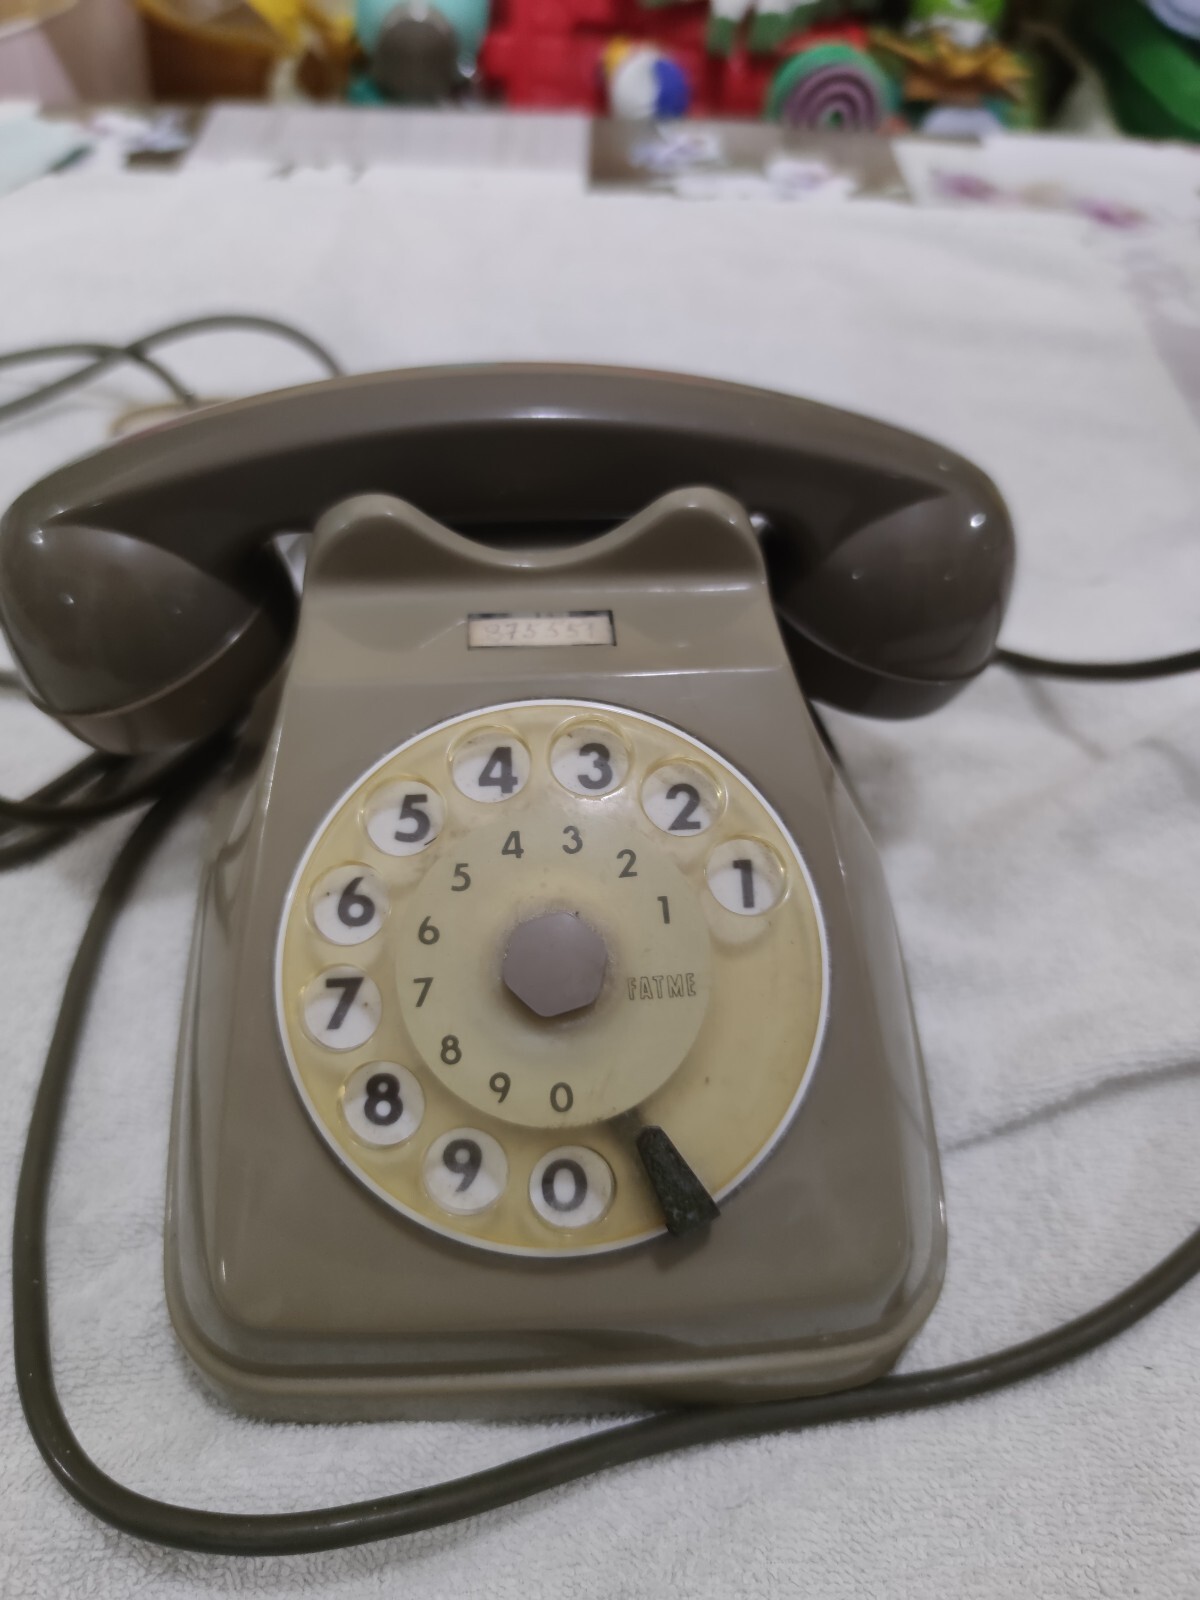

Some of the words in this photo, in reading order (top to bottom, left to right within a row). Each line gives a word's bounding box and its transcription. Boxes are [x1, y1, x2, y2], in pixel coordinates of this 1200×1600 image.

[478, 745, 519, 794] 4
[577, 741, 613, 790] 3
[394, 793, 432, 843] 5
[665, 782, 702, 831] 2
[501, 830, 525, 859] 4
[562, 825, 584, 855] 3
[450, 862, 472, 892] 5
[616, 848, 638, 879] 2
[731, 858, 755, 909] 1
[337, 876, 376, 928] 6
[657, 895, 671, 925] 1
[417, 915, 441, 946] 6
[324, 975, 365, 1030] 7
[413, 976, 434, 1008] 7
[626, 972, 697, 1001] FATME
[439, 1034, 462, 1066] 8
[363, 1072, 404, 1126] 8
[489, 1071, 511, 1104] 9
[549, 1082, 574, 1113] 0
[441, 1138, 484, 1192] 9
[540, 1157, 589, 1212] 0
